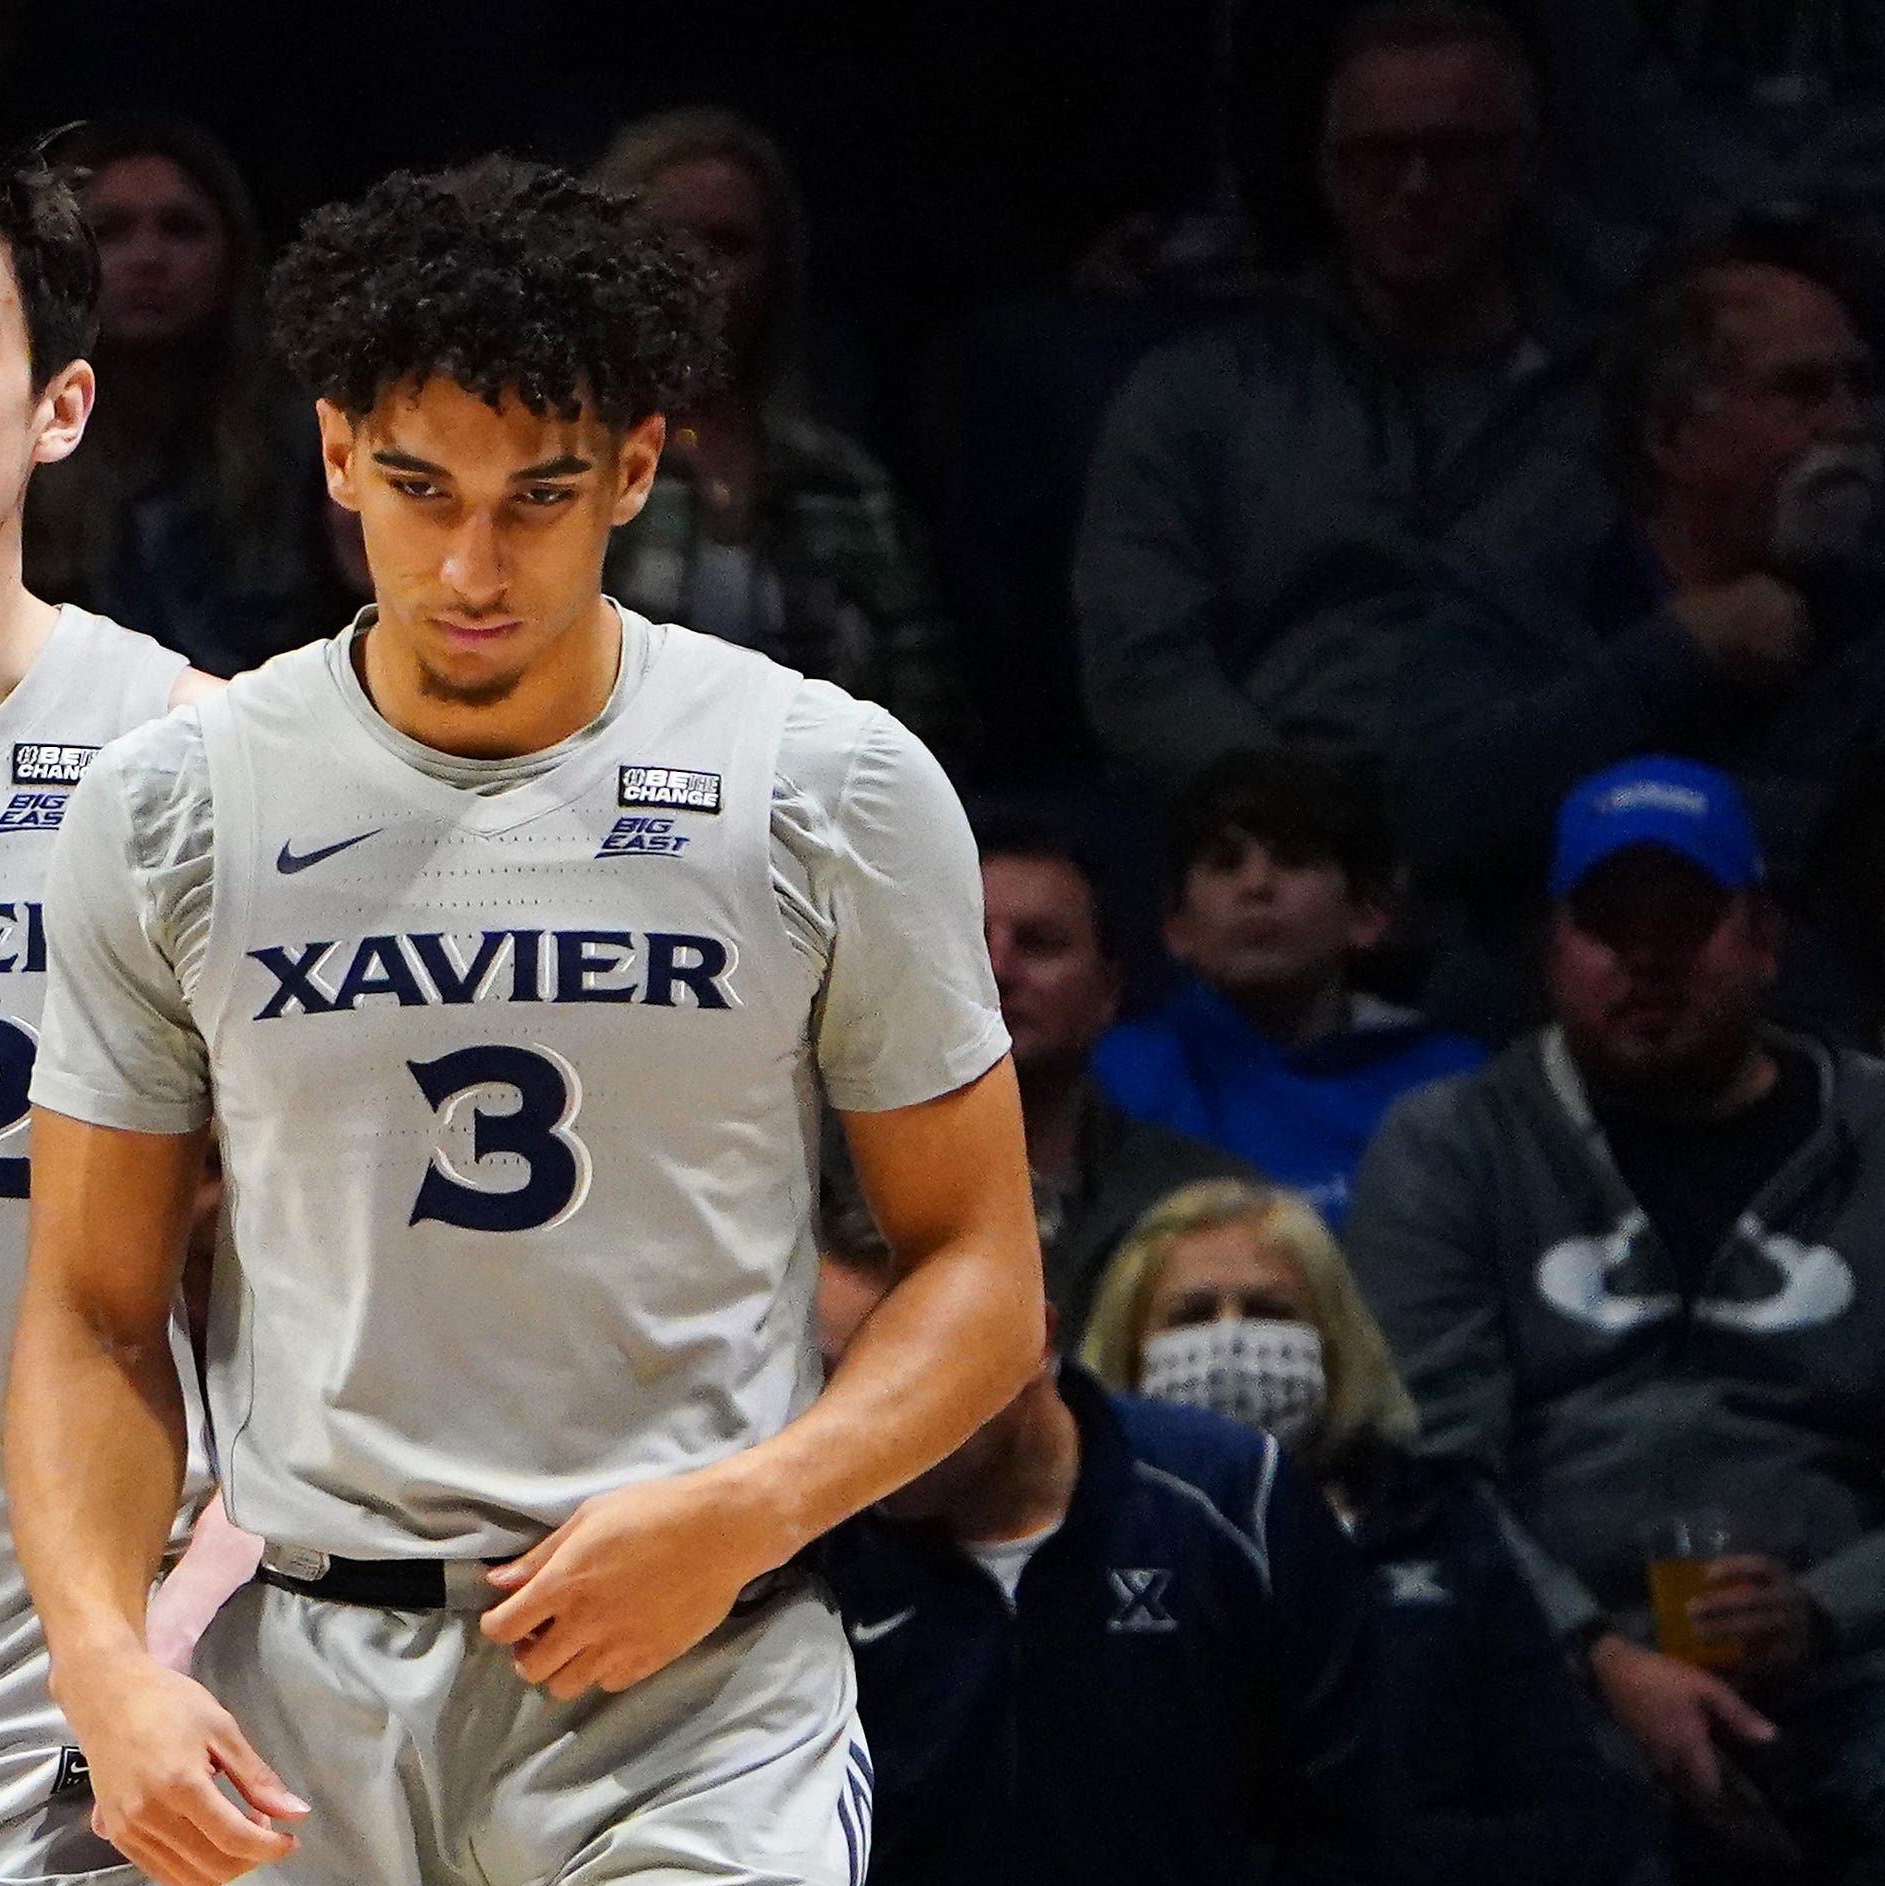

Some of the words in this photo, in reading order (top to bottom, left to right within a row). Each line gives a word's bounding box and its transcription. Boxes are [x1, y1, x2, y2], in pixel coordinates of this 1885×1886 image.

[17, 763, 88, 780] CHAN
[7, 794, 70, 810] BIG
[623, 786, 719, 808] CHANGE
[611, 817, 675, 834] BIG
[602, 833, 691, 852] EAST
[246, 928, 745, 1022] XAVIER
[406, 1042, 593, 1233] 3
